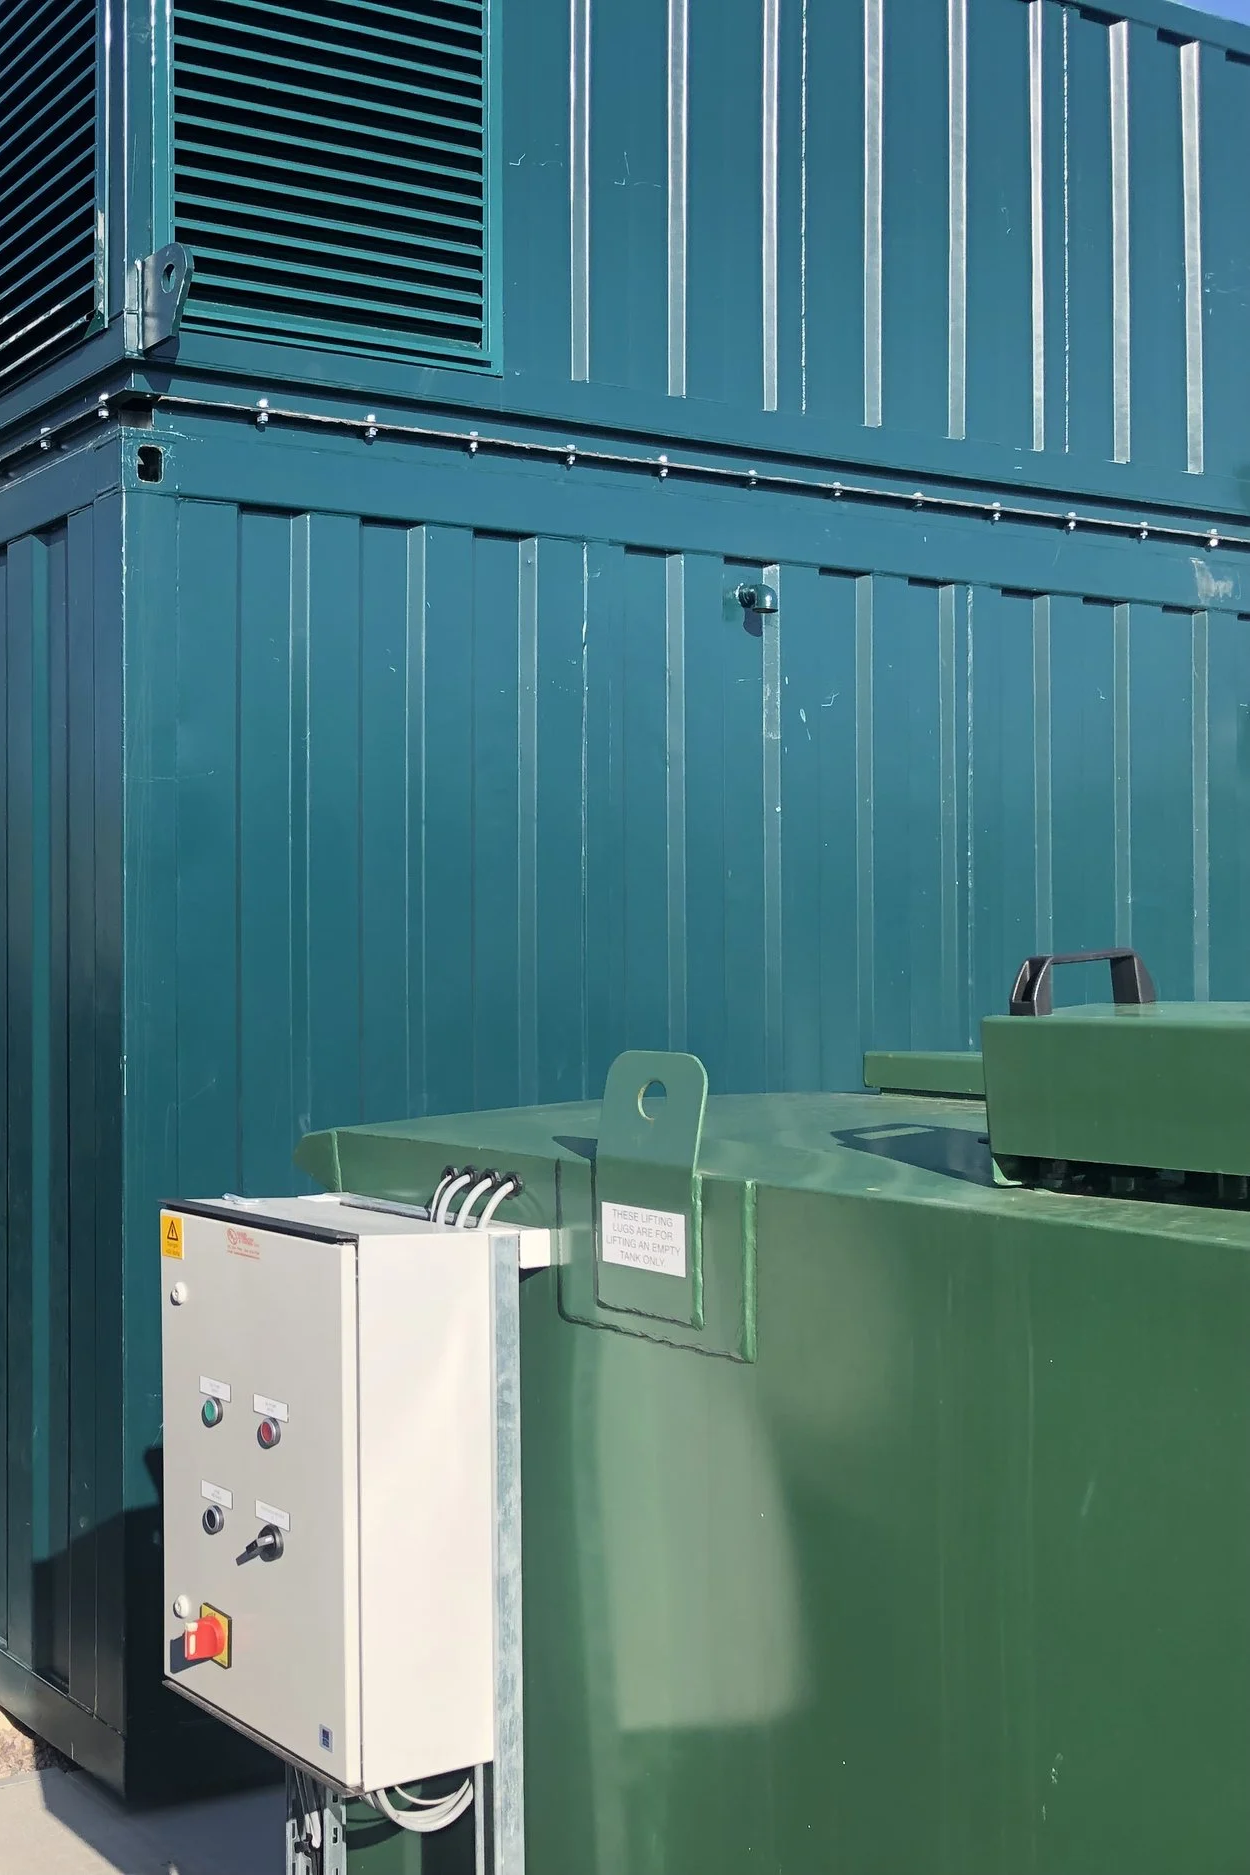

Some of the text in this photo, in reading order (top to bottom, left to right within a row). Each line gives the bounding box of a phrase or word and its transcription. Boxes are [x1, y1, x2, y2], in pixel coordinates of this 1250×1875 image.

[612, 1208, 674, 1227] THESE LIFTING
[612, 1223, 673, 1240] LUGS ARE FOR
[606, 1236, 681, 1257] LIFTING AN EMPTY
[620, 1250, 641, 1263] TANK
